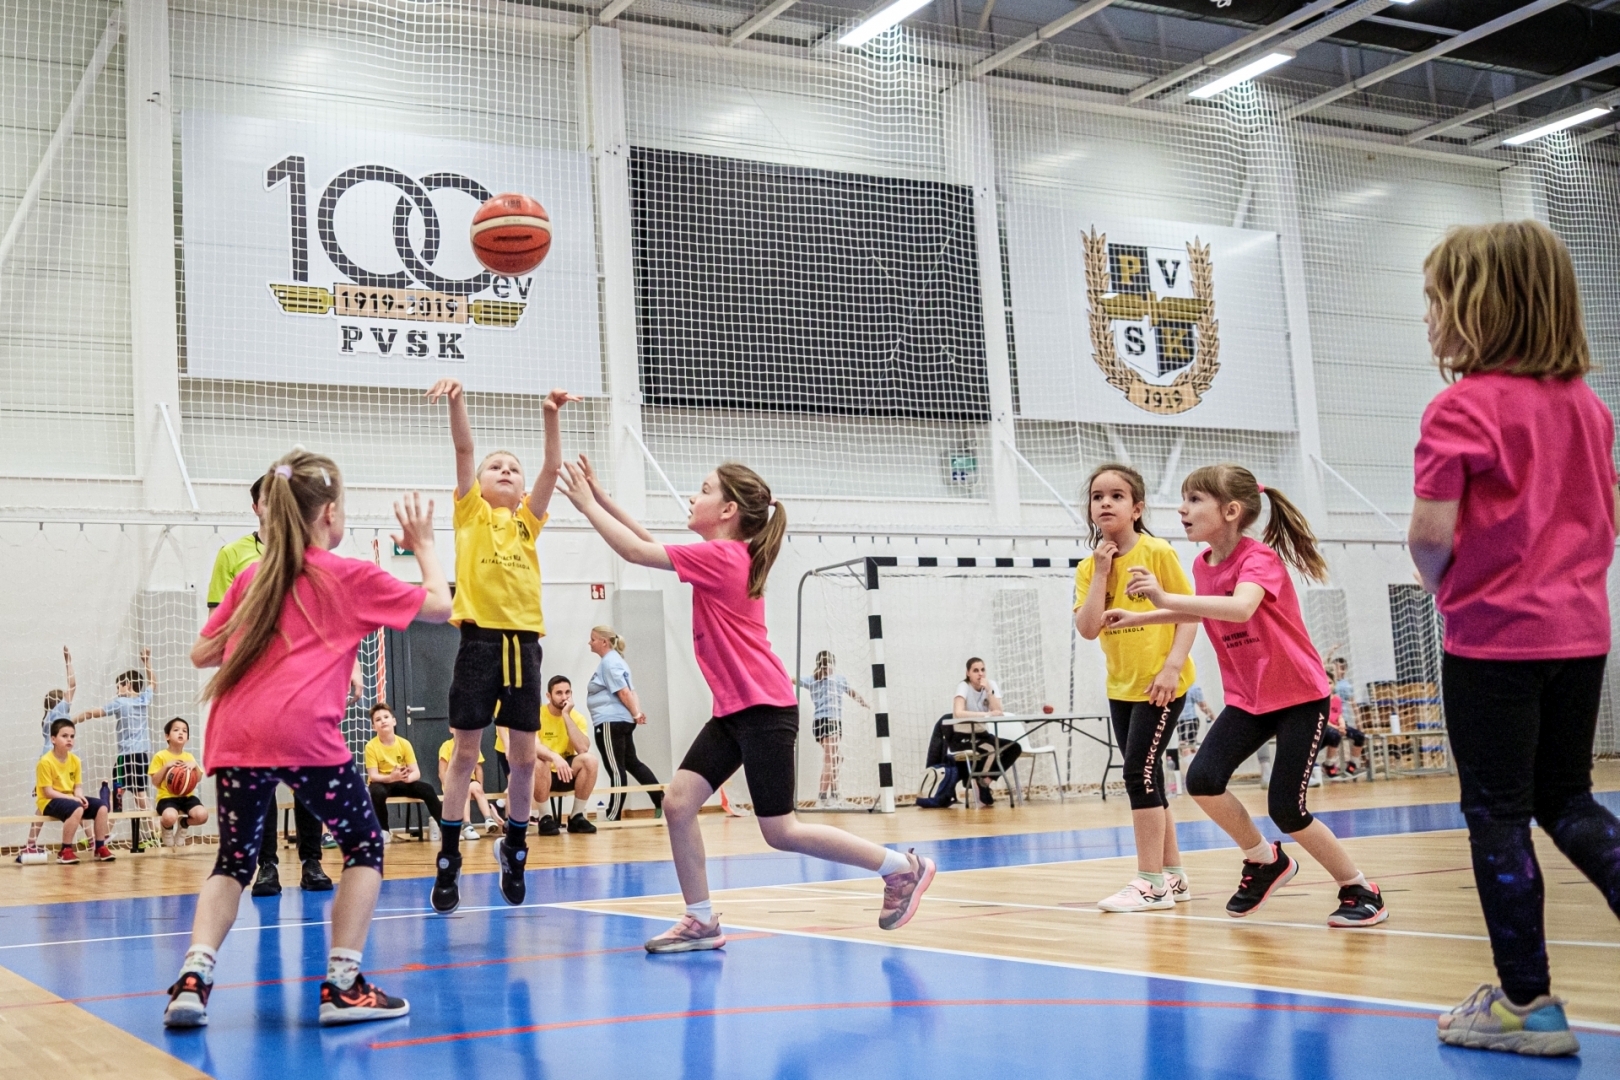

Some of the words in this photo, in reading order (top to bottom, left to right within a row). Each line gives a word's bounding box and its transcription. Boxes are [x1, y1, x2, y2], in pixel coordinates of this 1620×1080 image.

[265, 154, 494, 295] 100
[1118, 254, 1141, 285] P
[1156, 258, 1181, 288] V
[341, 291, 459, 318] 1919-2019
[340, 325, 465, 359] PVSK
[1124, 325, 1146, 356] S
[1163, 327, 1190, 359] K
[1143, 388, 1184, 408] 1919
[1122, 626, 1145, 634] ISKOLA
